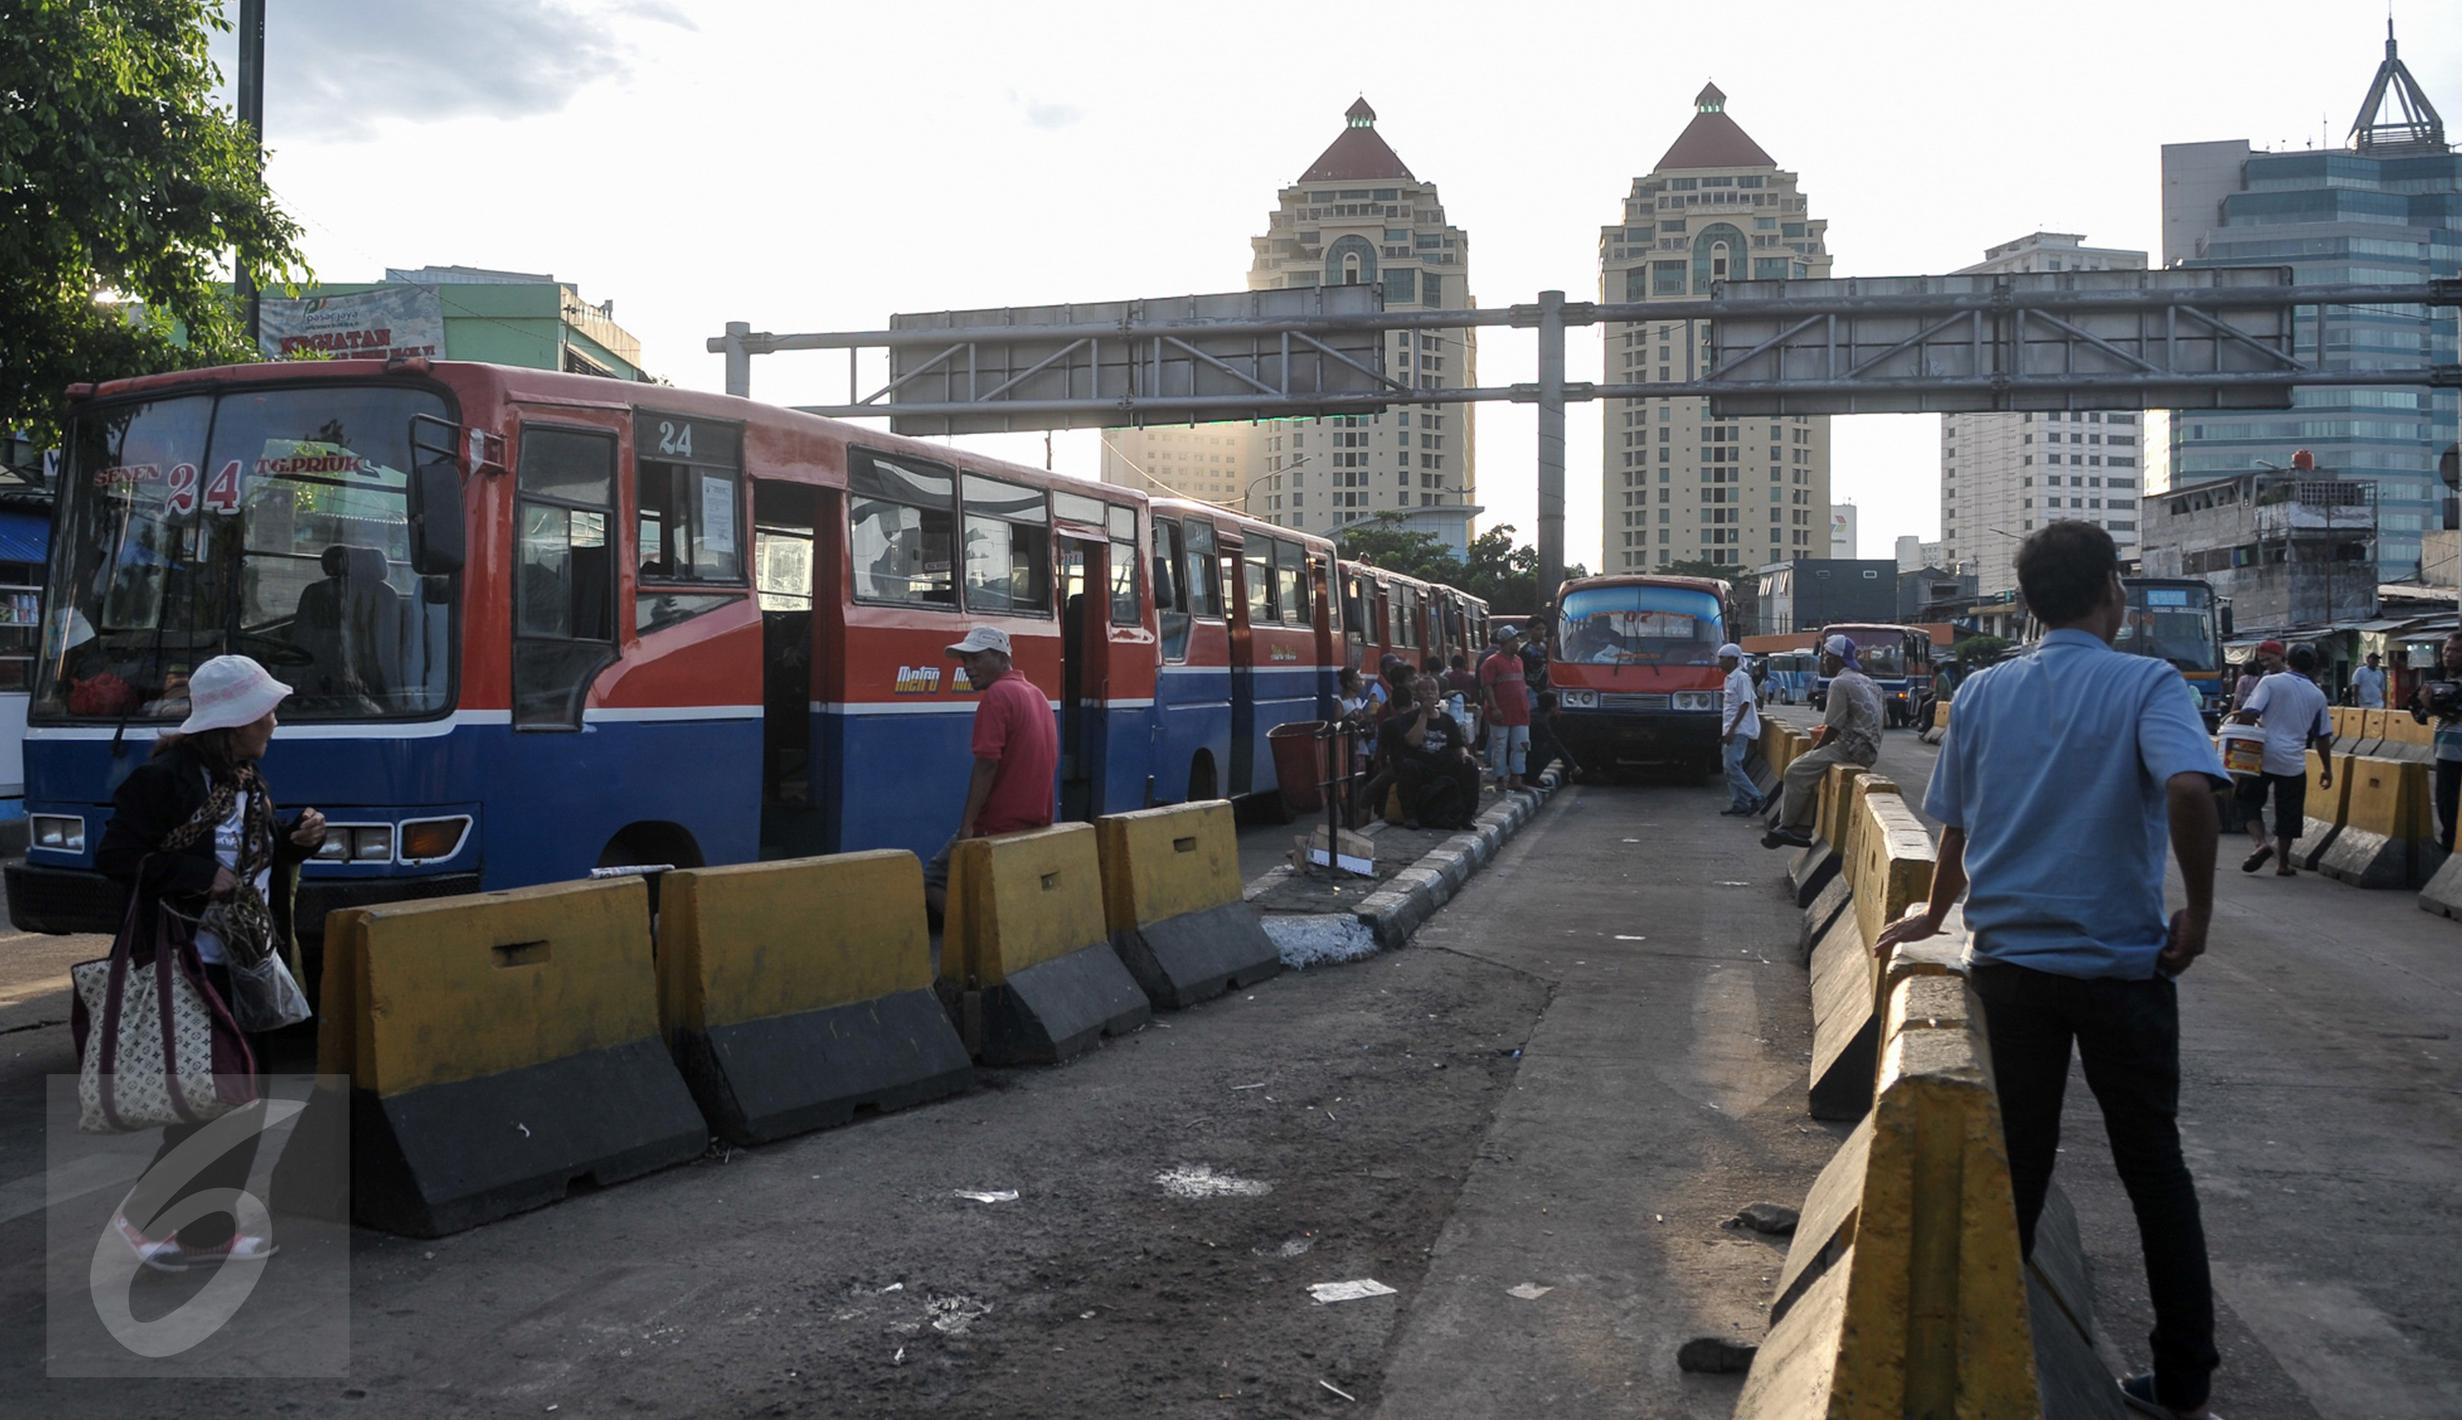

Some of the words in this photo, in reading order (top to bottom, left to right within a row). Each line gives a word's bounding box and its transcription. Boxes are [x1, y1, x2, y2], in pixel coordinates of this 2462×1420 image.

[306, 312, 335, 324] pasar
[280, 329, 391, 353] KEGIATAN
[659, 421, 692, 457] 24
[94, 463, 160, 487] SENEN
[164, 459, 243, 517] 24
[255, 456, 364, 476] TG.PRIUK
[895, 666, 940, 694] Metro
